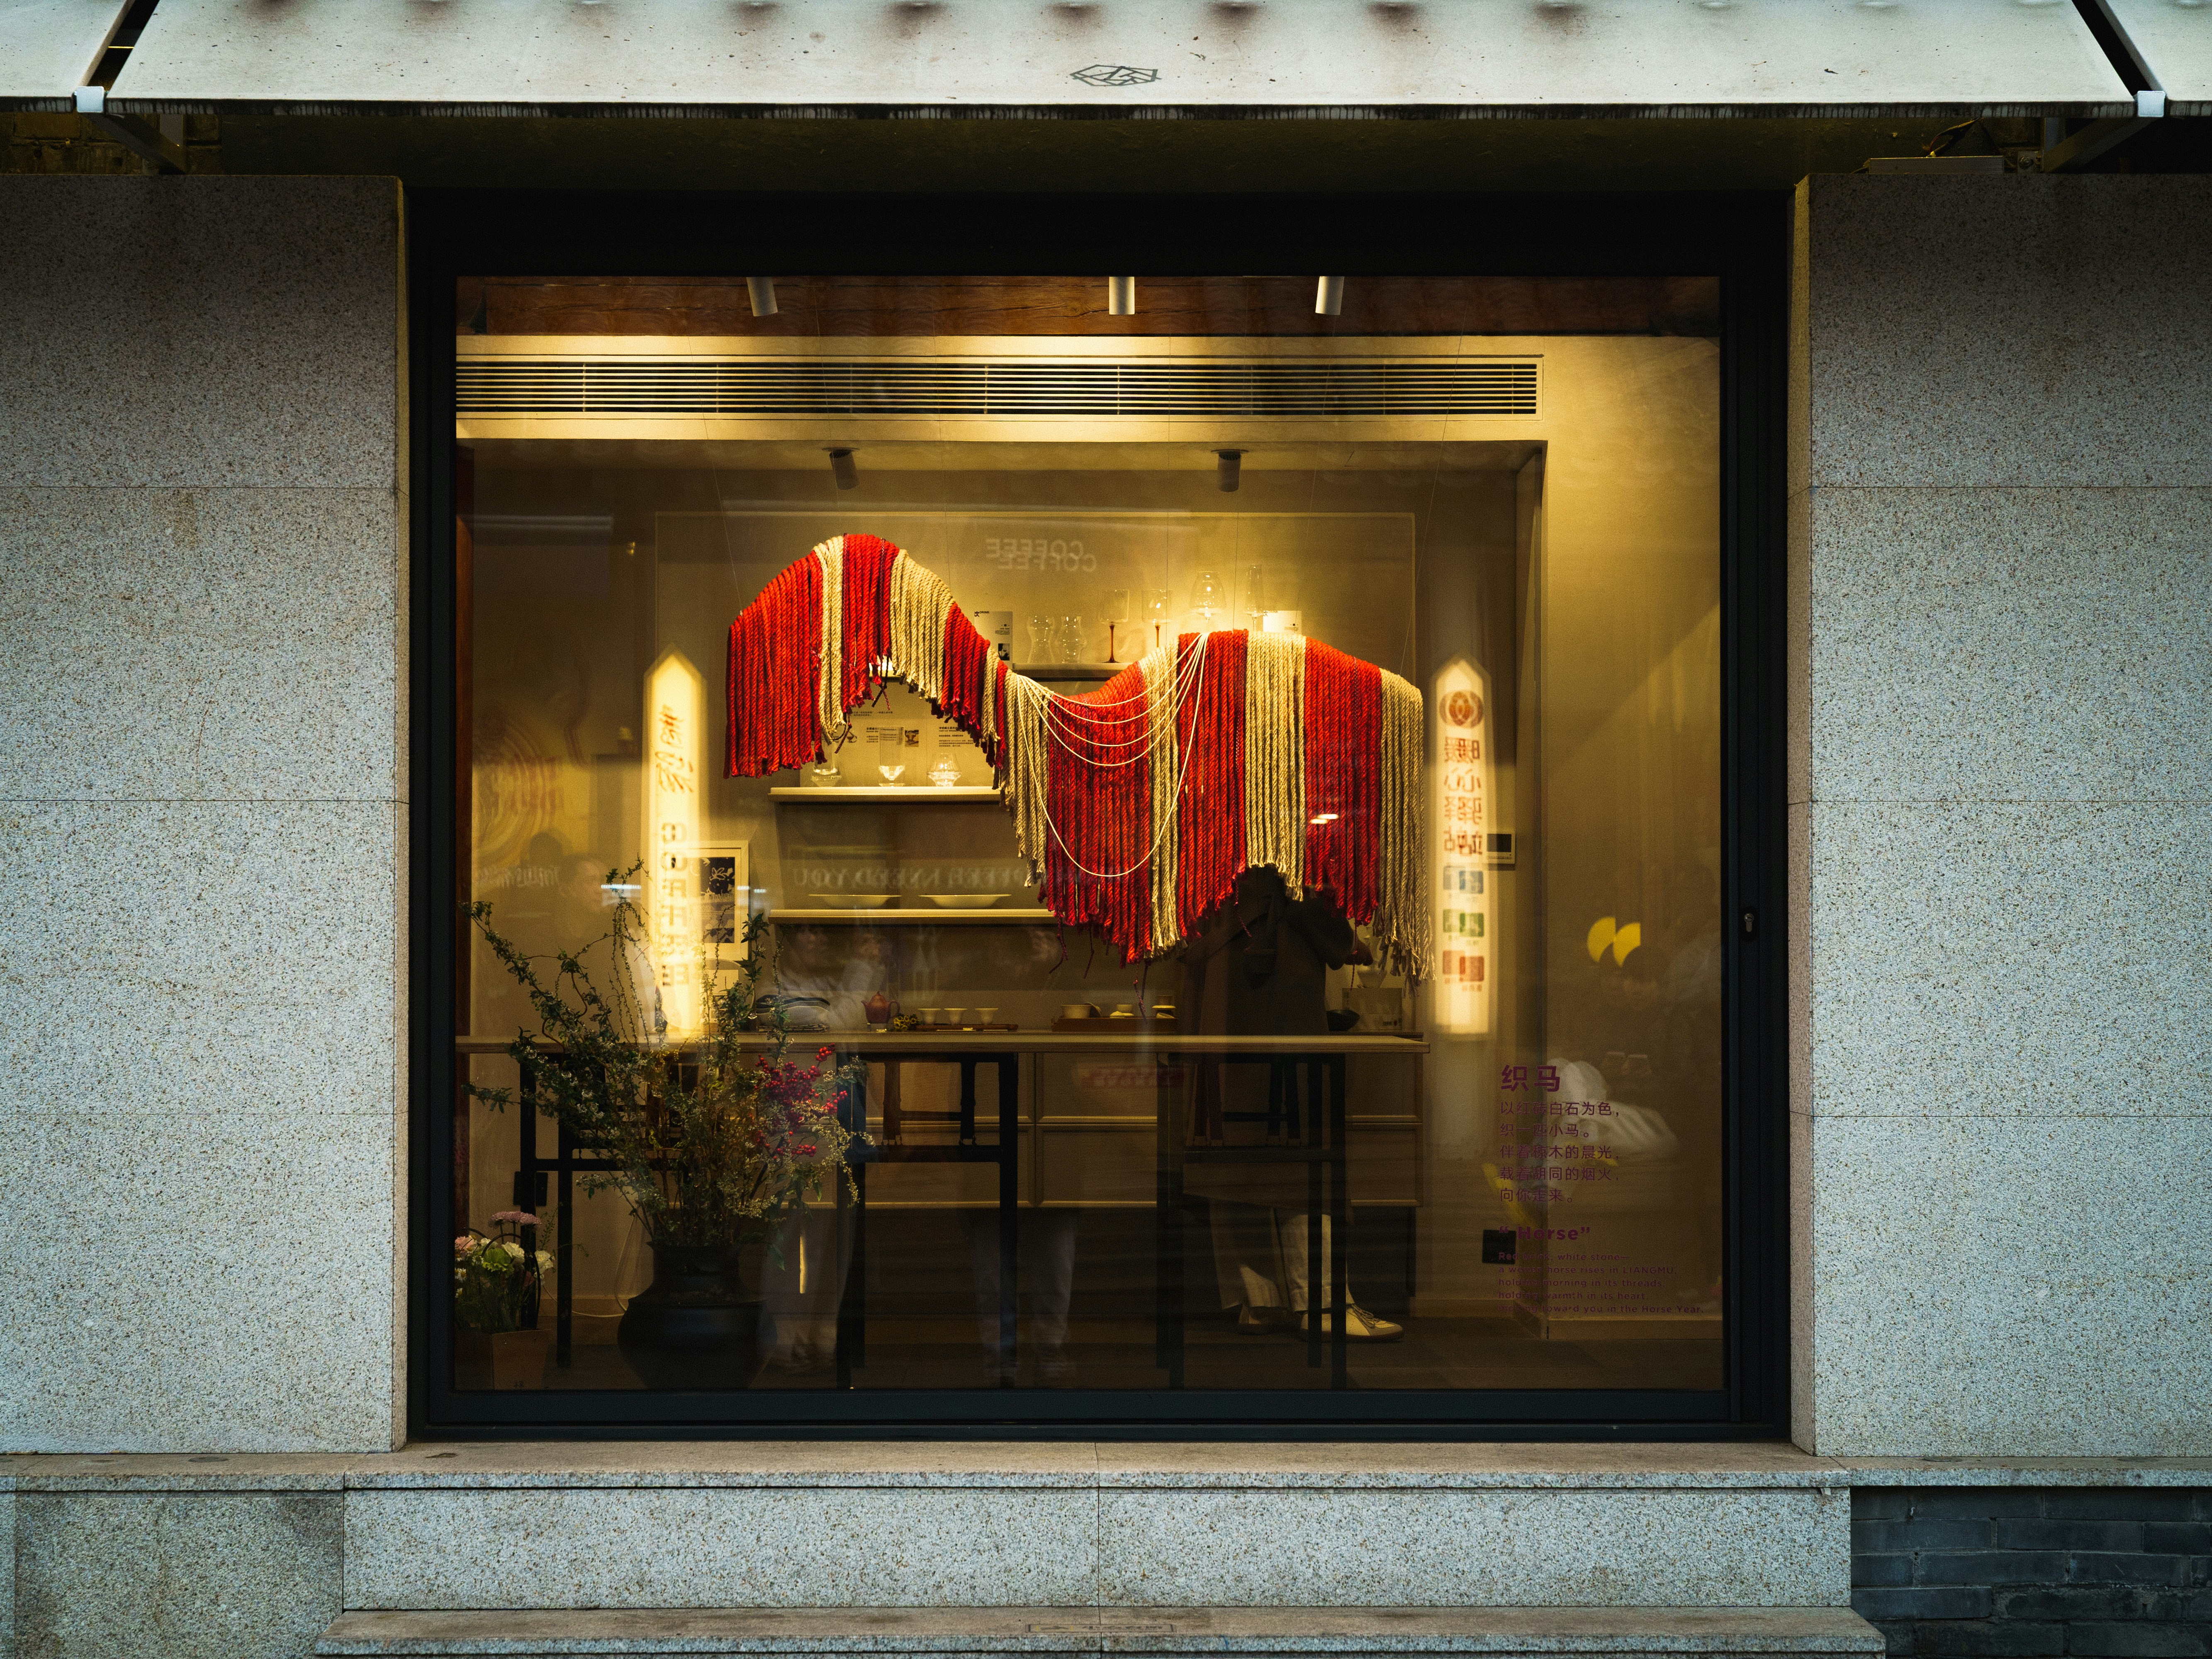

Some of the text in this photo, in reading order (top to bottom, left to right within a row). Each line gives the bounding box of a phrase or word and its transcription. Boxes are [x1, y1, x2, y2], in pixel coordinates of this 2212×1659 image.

[1501, 1064, 1560, 1092] 织马
[1500, 1101, 1620, 1117] 以红砖白石为色，
[1500, 1123, 1590, 1138] 织一匹小马。
[1500, 1188, 1573, 1203] 向你走来。
[1543, 1280, 1587, 1288] morning
[1542, 1305, 1579, 1313] toward
